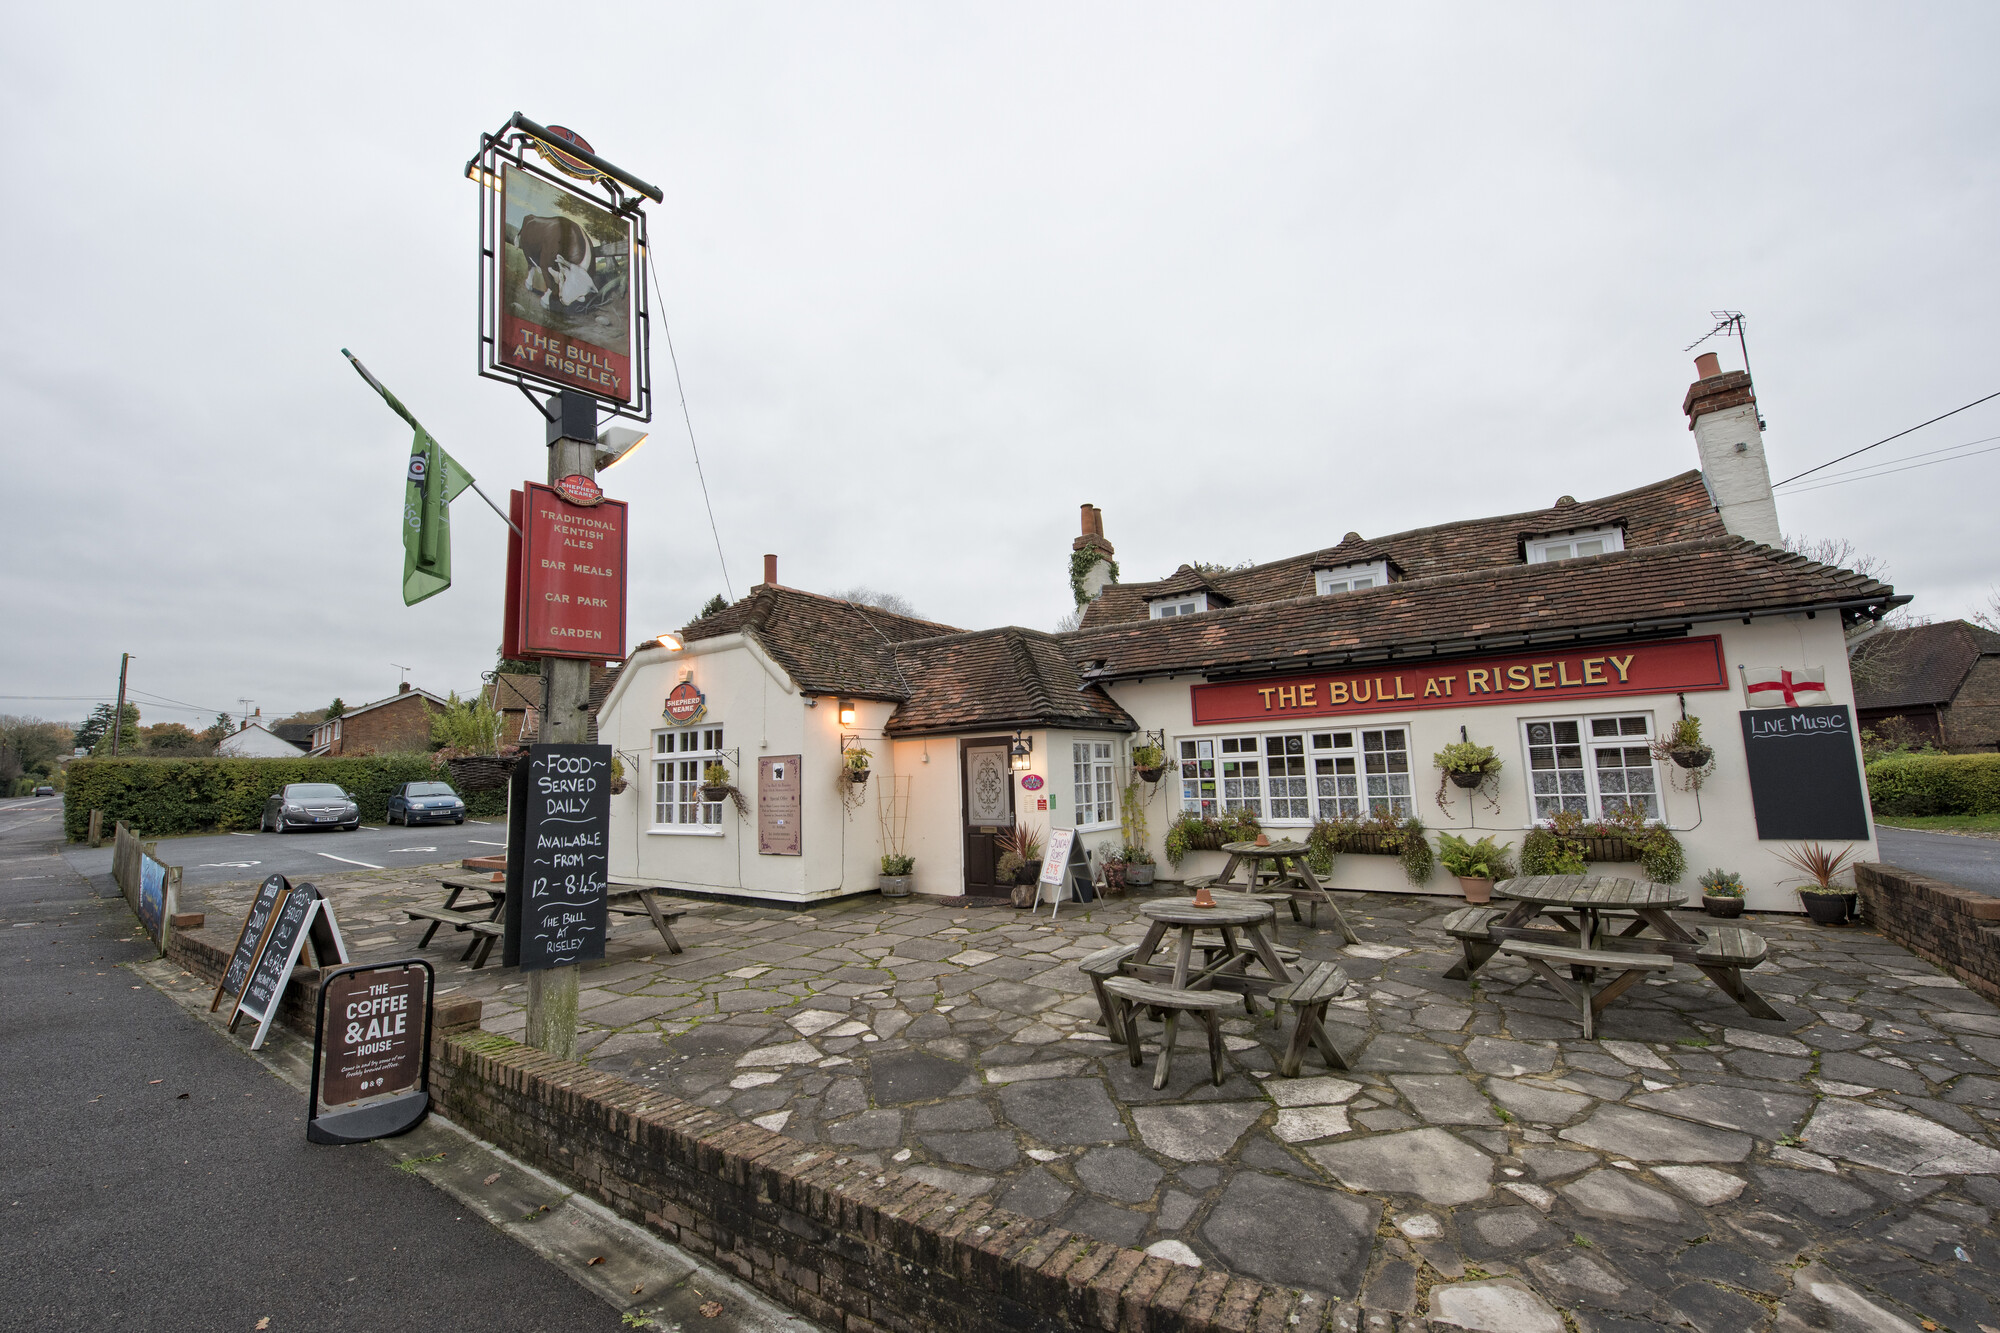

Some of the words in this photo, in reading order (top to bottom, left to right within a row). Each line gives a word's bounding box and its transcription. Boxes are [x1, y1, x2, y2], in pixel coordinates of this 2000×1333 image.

[520, 328, 560, 354] THE
[566, 344, 615, 373] BULL
[513, 344, 538, 362] AT
[545, 354, 621, 389] RISELEY
[561, 482, 600, 495] SHEPHERD
[568, 489, 593, 498] NEAME
[540, 510, 616, 531] TRADITIONAL
[553, 524, 604, 540] KENTISH
[563, 537, 594, 550] ALES
[541, 559, 566, 571] BAR
[573, 563, 613, 577] MEALS
[545, 592, 570, 604] CAR
[577, 596, 608, 608] PARK
[550, 626, 602, 640] GARDEN
[1258, 684, 1317, 711] THE
[1330, 676, 1416, 706] BULL
[1424, 676, 1457, 698] AT
[1467, 654, 1636, 695] RISELEY
[667, 697, 700, 707] SHEPHERD
[672, 705, 695, 714] NEAME
[1751, 716, 1787, 734] LIVE
[547, 754, 592, 774] FOOD
[537, 777, 597, 795] SERVED
[546, 798, 590, 815] DAILY
[537, 831, 602, 850] AVAILABLE
[553, 854, 585, 868] FROM
[532, 877, 549, 898] 12
[541, 915, 559, 928] THE
[562, 912, 586, 925] BULL
[556, 926, 568, 938] AT
[546, 937, 585, 954] RISELEY
[369, 983, 389, 997] THE
[346, 994, 409, 1020] COFFEE
[357, 1039, 392, 1057] HOUSE
[345, 1069, 363, 1079] freshly
[363, 1065, 382, 1074] brewed
